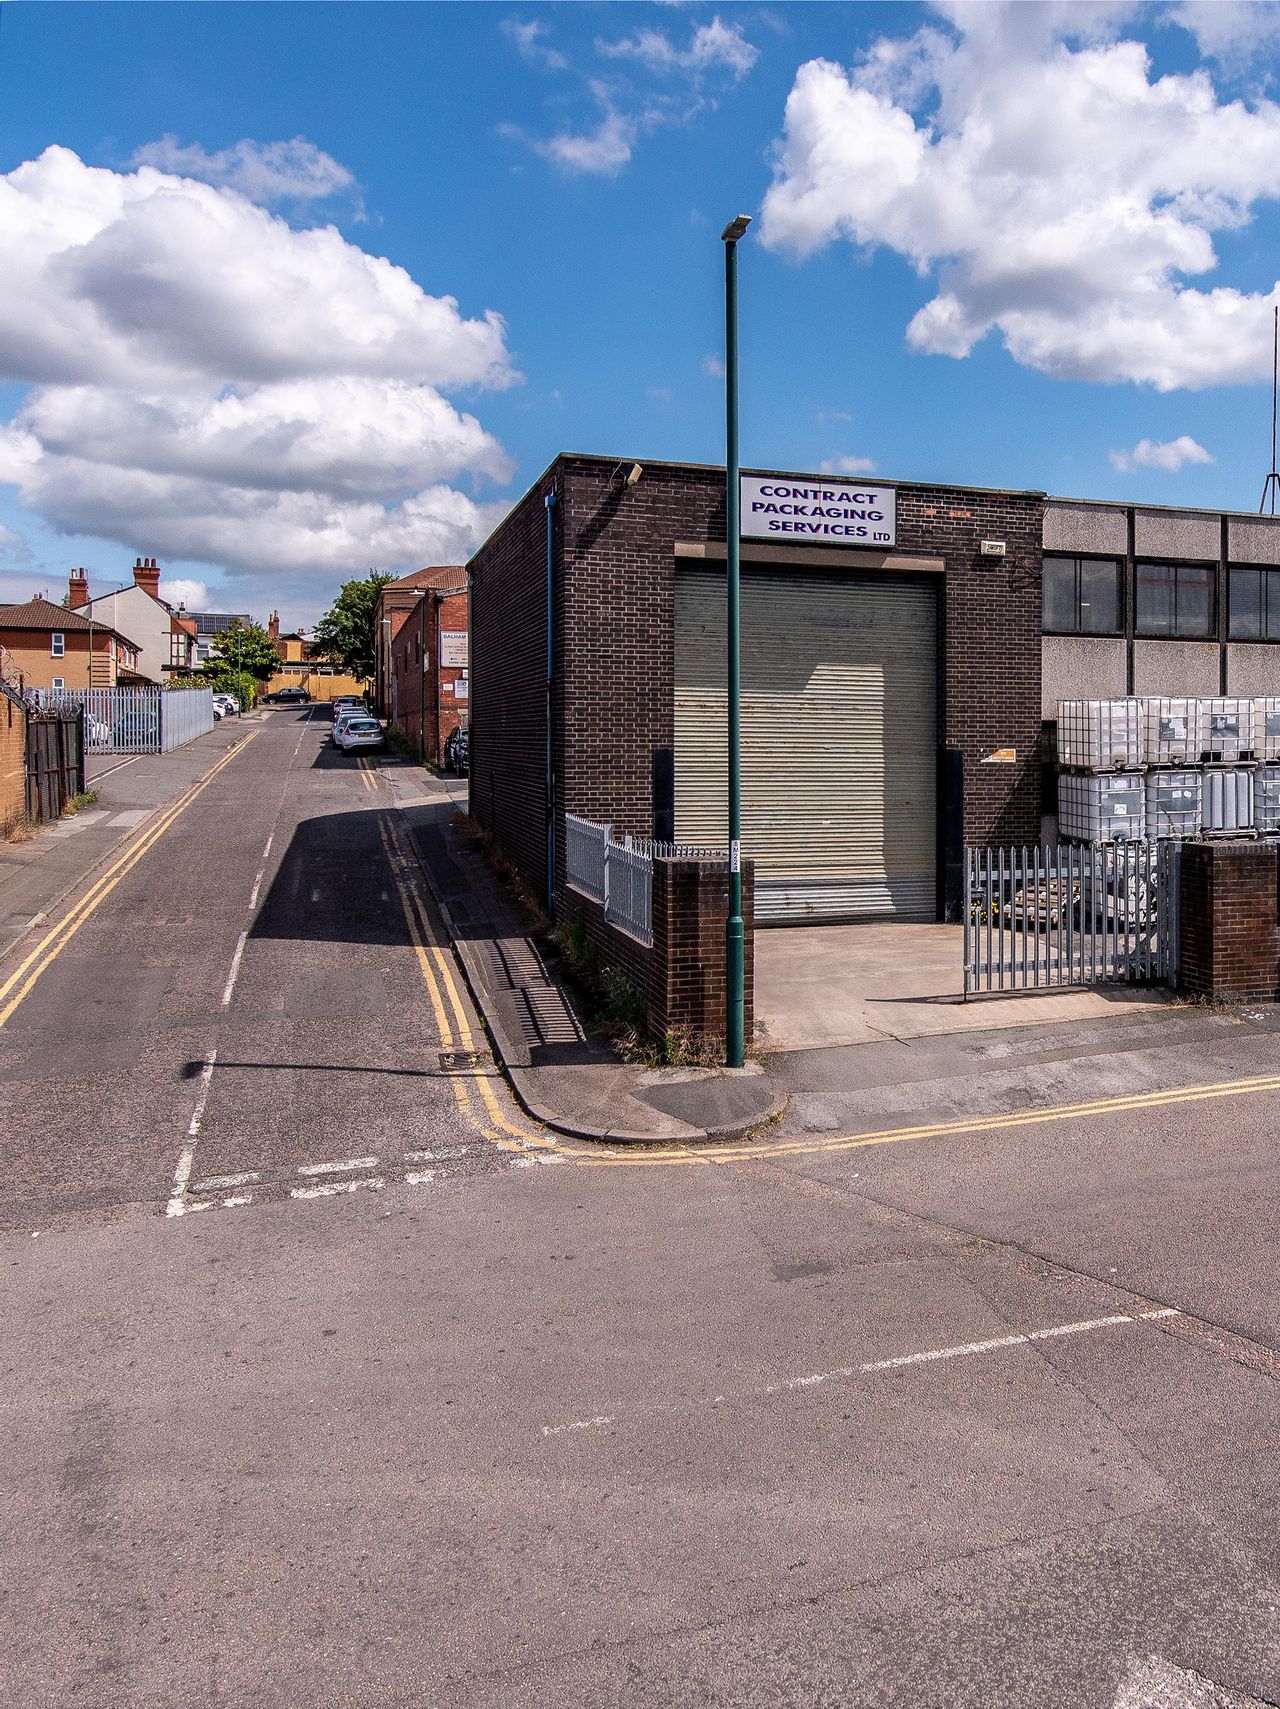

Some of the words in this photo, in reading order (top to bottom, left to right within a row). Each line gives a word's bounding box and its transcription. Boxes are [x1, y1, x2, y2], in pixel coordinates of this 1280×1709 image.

[760, 485, 878, 504] CONTRACT
[752, 501, 884, 521] PACKAGING
[768, 520, 868, 537] SERVICES
[873, 532, 890, 541] LTD
